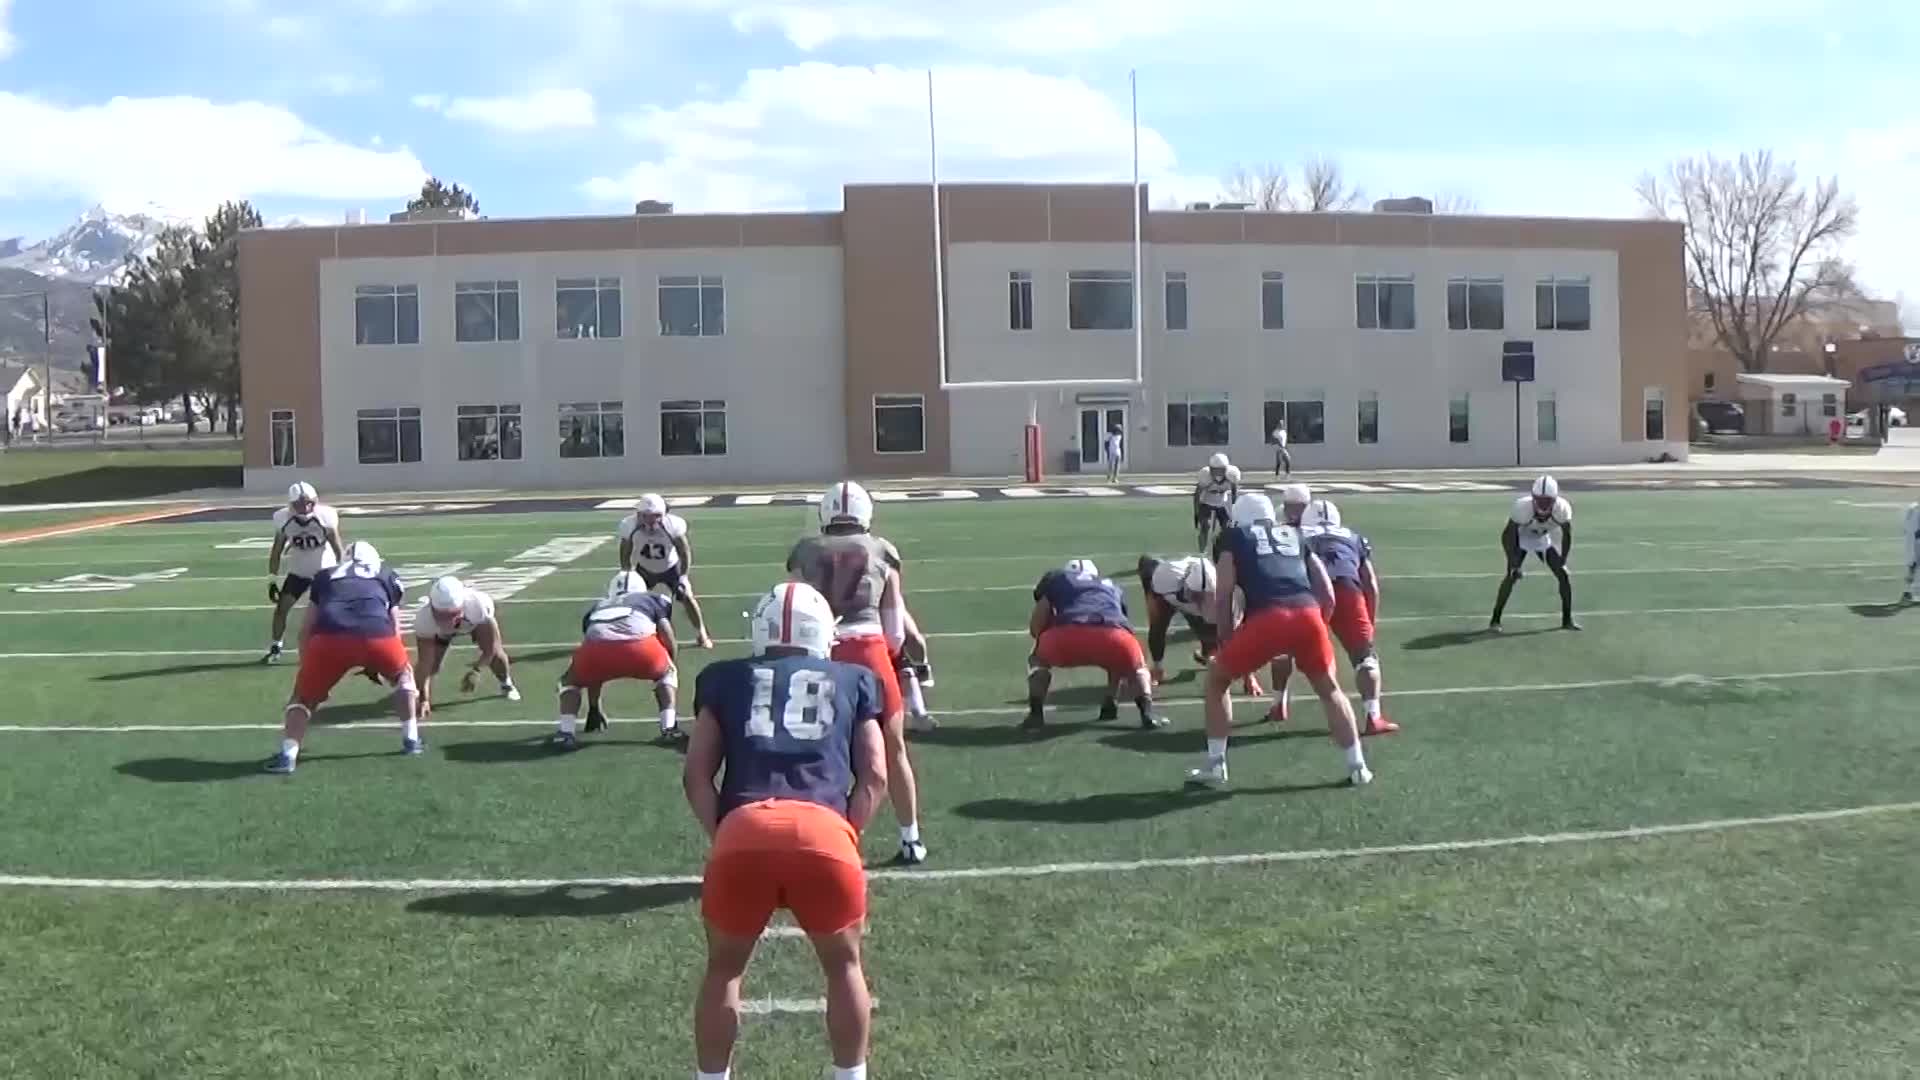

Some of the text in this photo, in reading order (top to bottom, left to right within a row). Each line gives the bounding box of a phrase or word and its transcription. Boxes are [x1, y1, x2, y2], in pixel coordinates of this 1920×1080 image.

[639, 543, 666, 560] 43
[1251, 525, 1301, 556] 19
[745, 668, 836, 740] 18
